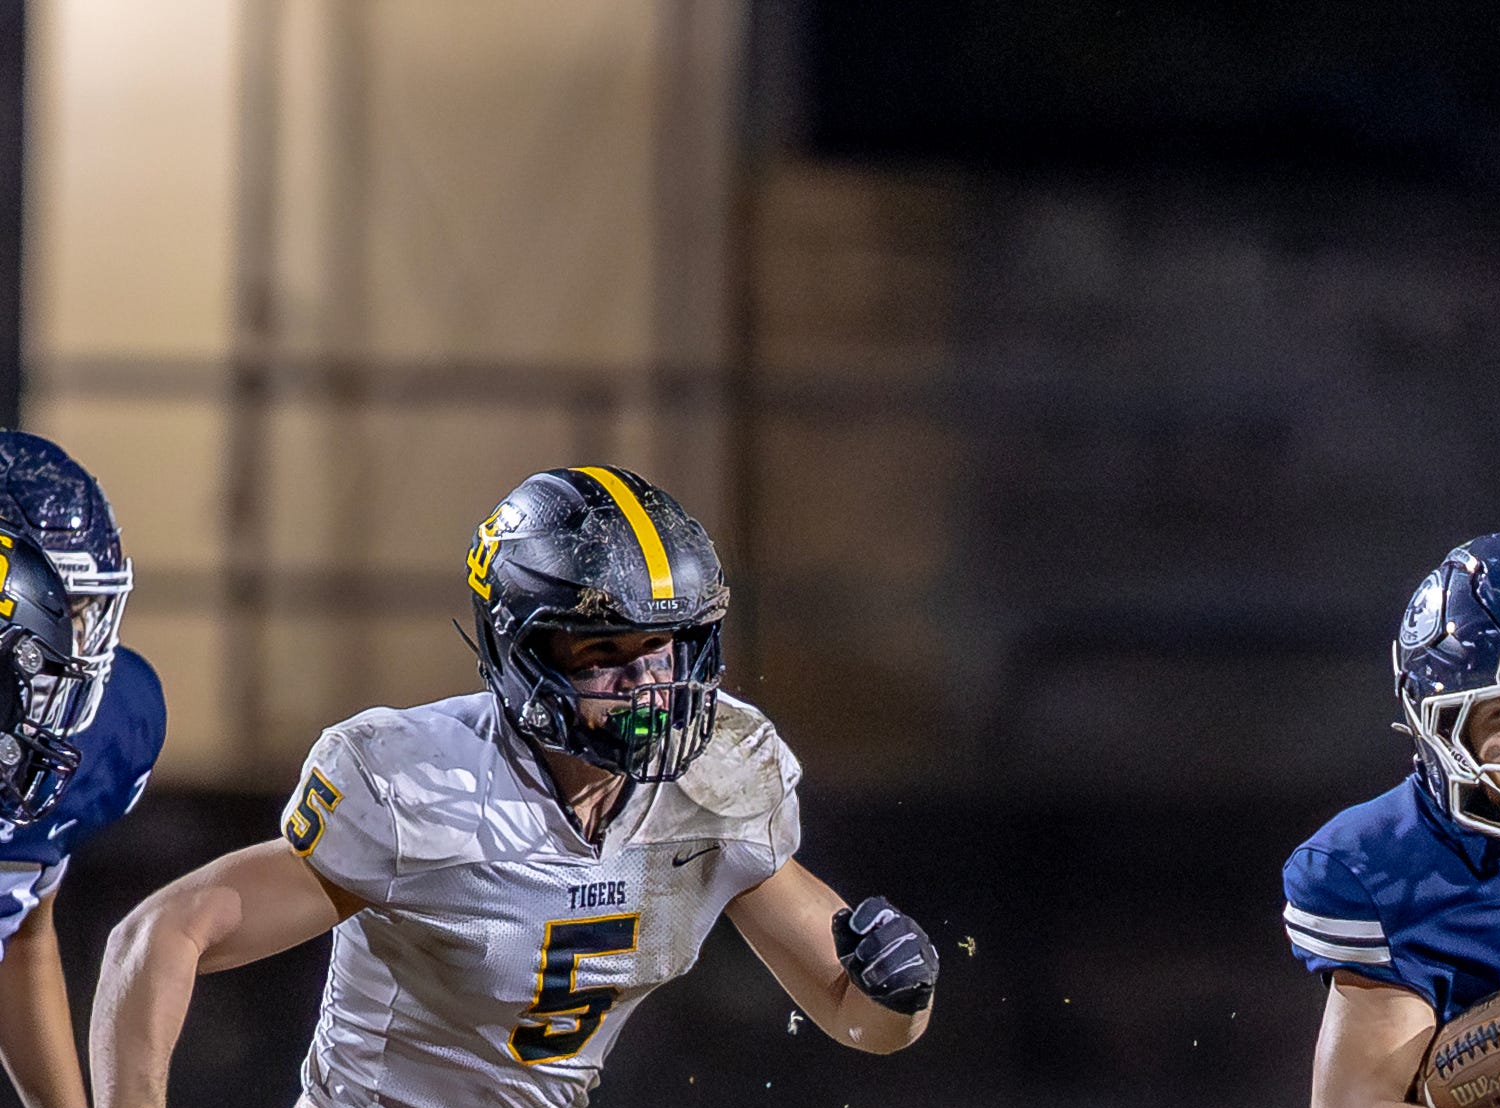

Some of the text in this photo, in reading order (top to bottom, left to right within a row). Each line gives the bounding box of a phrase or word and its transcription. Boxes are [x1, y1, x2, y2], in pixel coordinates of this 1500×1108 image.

[646, 599, 679, 611] VICIS
[285, 767, 344, 857] 5
[567, 880, 627, 910] TIGERS
[507, 912, 640, 1065] 5
